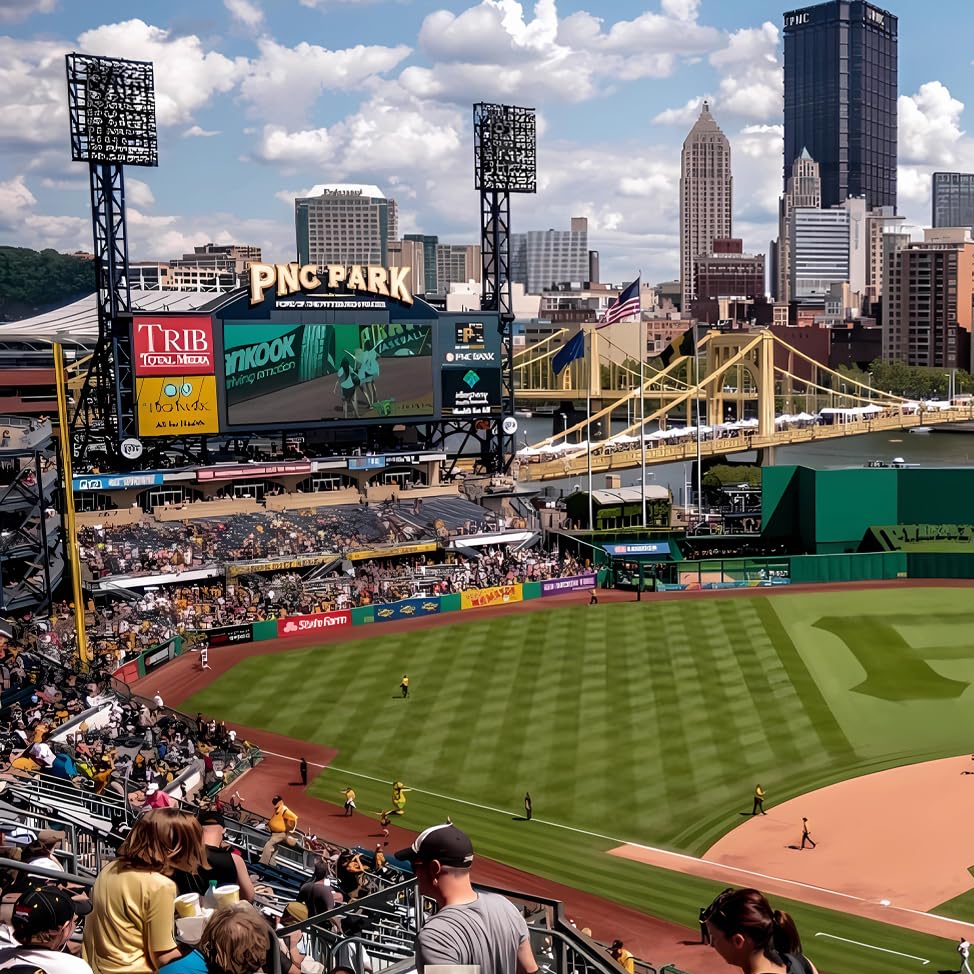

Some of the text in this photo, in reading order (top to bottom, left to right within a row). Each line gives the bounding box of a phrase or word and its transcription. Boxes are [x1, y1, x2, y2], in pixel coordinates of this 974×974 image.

[250, 263, 415, 306] PNC PARK
[138, 324, 208, 352] TRIB
